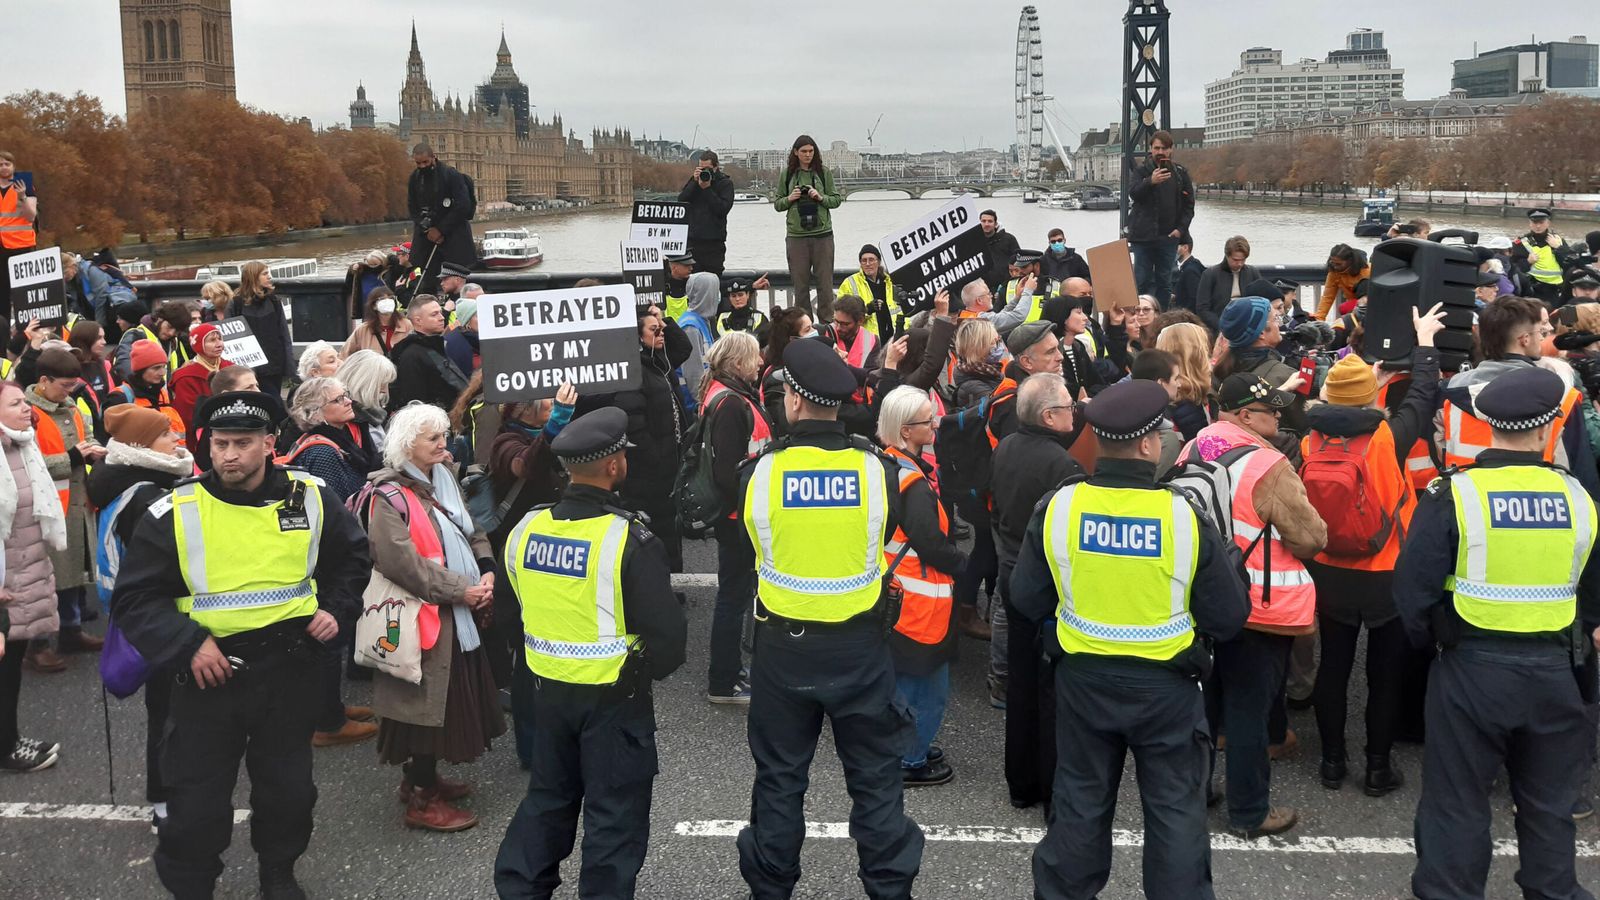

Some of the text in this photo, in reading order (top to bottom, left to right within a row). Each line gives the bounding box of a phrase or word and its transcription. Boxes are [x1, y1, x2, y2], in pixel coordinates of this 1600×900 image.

[637, 204, 686, 219] BETRAYED
[647, 227, 672, 238] BY MY
[890, 206, 968, 261] BETRAYED
[625, 247, 659, 263] BETRAYED
[920, 245, 958, 276] BY MY
[13, 256, 57, 280] BETRAYED
[635, 274, 653, 288] BY MY
[27, 287, 48, 304] BY MY
[493, 296, 621, 328] BETRAYED
[530, 339, 591, 362] BY MY
[495, 361, 629, 392] GOVERNMENT
[786, 476, 857, 501] POLICE
[1493, 497, 1568, 522] POLICE
[1083, 519, 1157, 550] POLICE
[526, 540, 586, 571] POLICE
